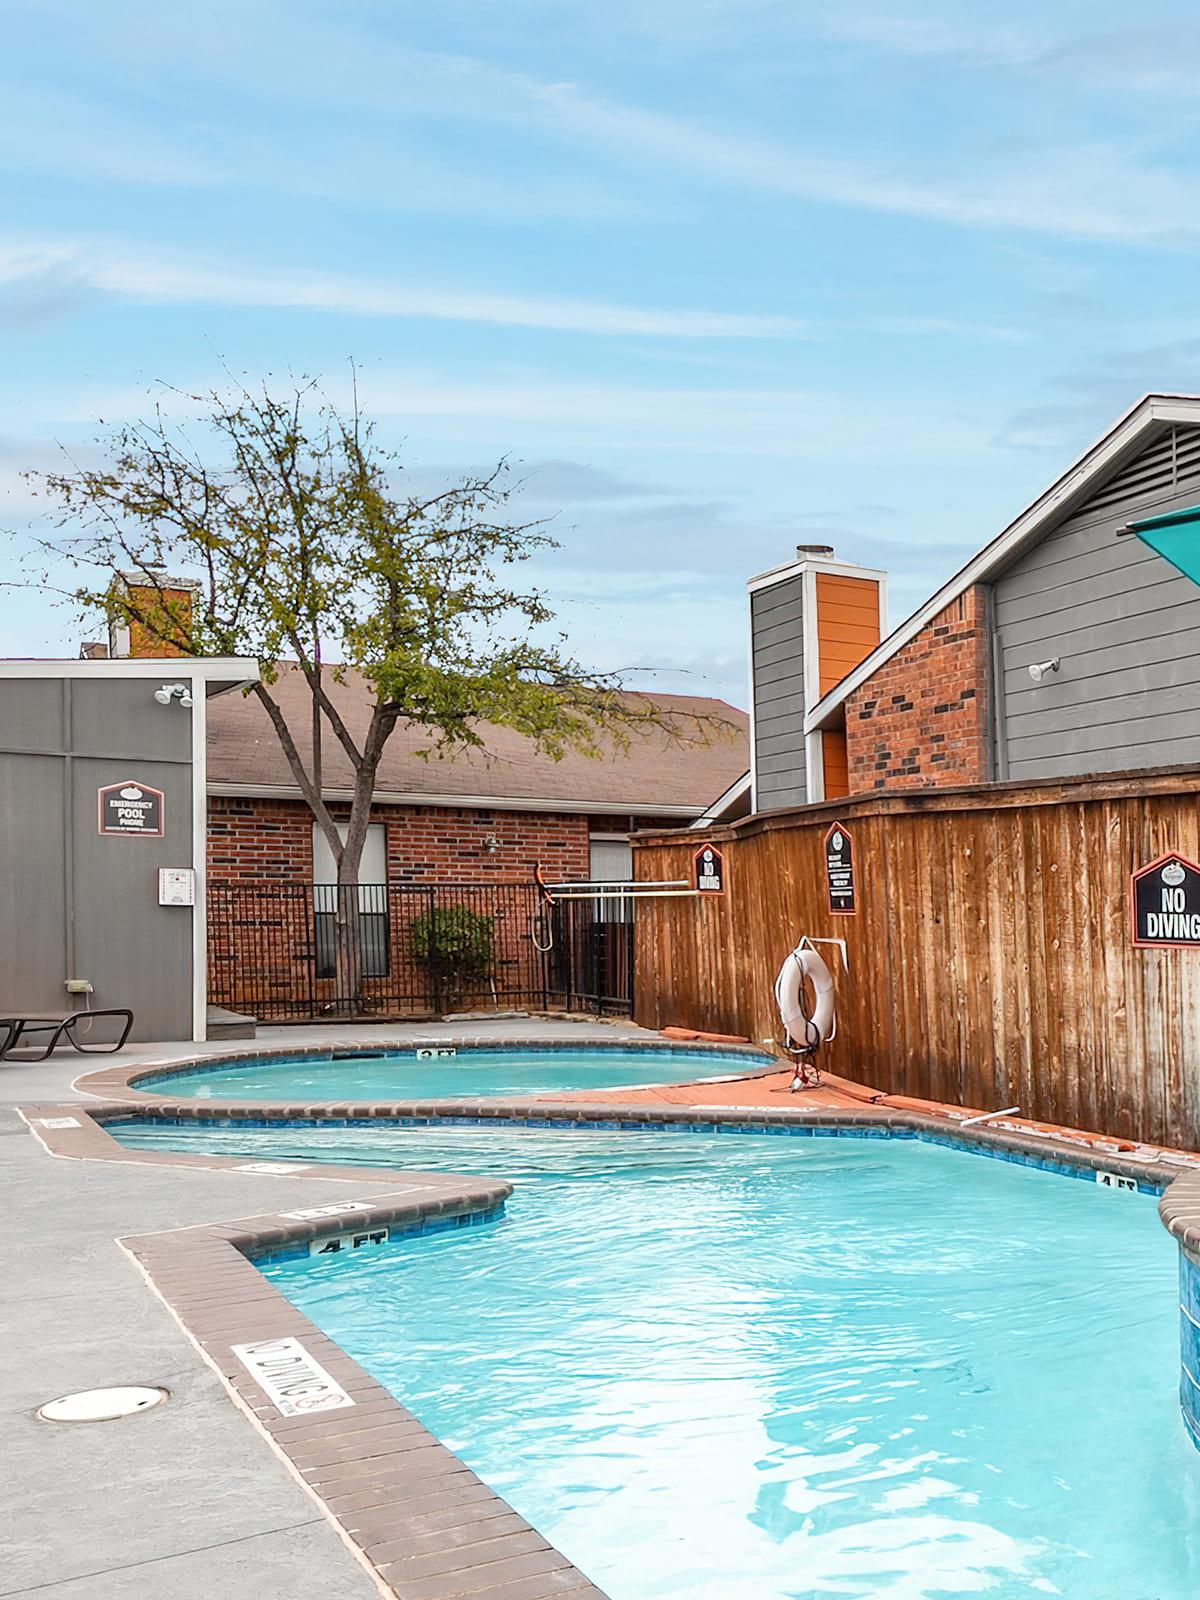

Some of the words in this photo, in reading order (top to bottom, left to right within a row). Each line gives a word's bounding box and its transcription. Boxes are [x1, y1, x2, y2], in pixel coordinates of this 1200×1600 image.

[118, 808, 145, 819] POOL
[1162, 888, 1185, 913] NO
[1103, 1176, 1111, 1186] 4
[319, 1240, 346, 1254] 4
[354, 1231, 386, 1248] FT
[256, 1357, 329, 1396] DIVING
